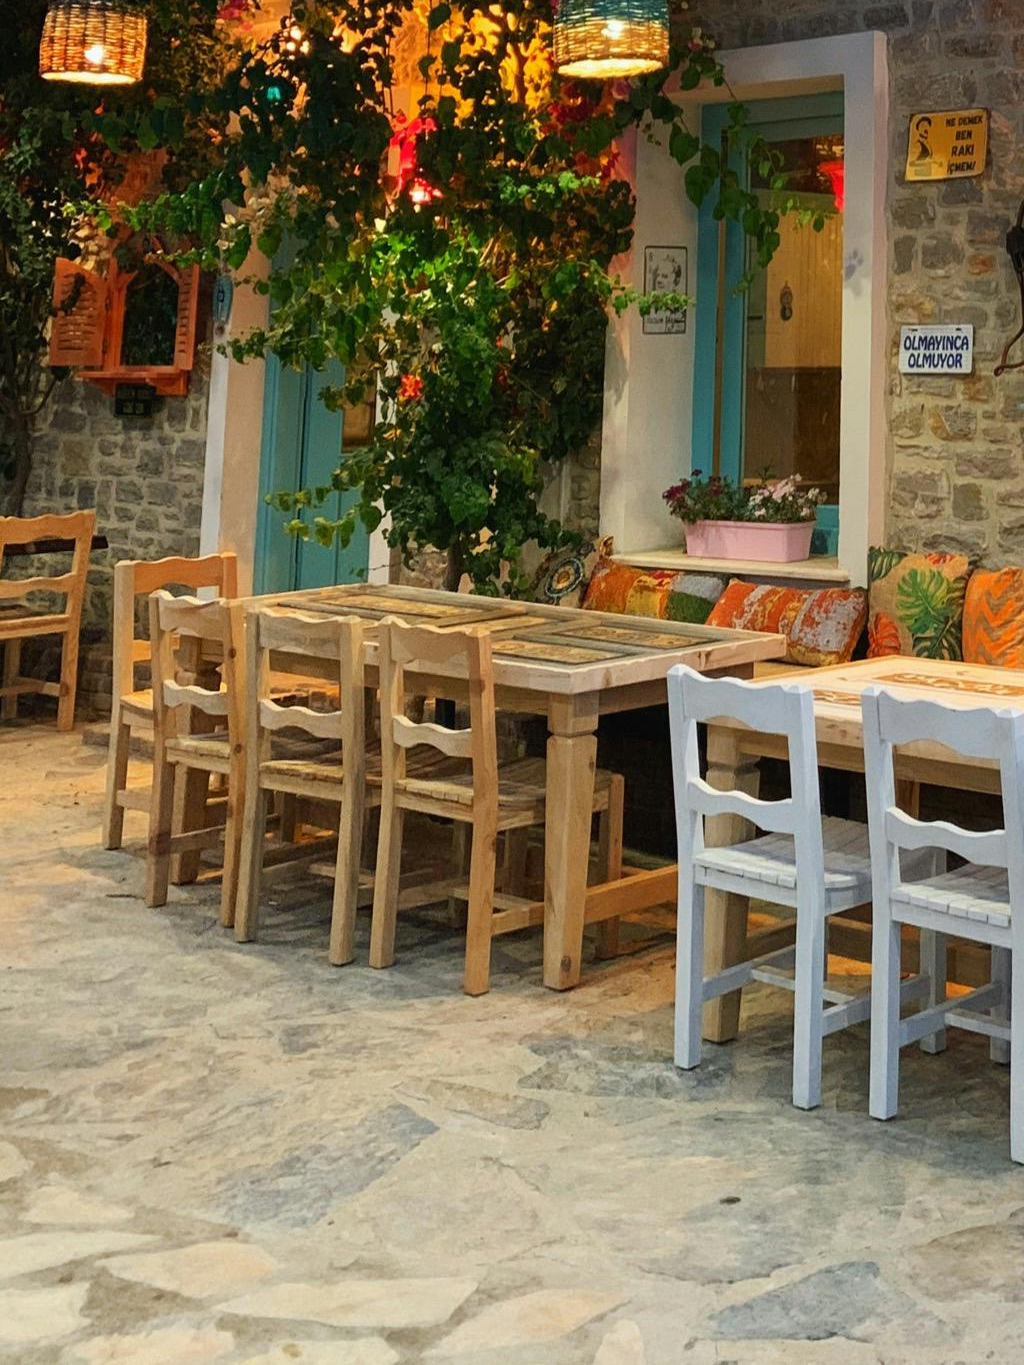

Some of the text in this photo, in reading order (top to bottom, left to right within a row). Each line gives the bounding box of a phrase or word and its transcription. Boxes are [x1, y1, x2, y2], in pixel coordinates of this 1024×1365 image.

[945, 115, 983, 127] NE DEMEK
[955, 129, 973, 141] BEN
[951, 144, 975, 157] RAKI
[903, 335, 969, 351] OLMAYINCA
[907, 353, 963, 369] OLMUYOR
